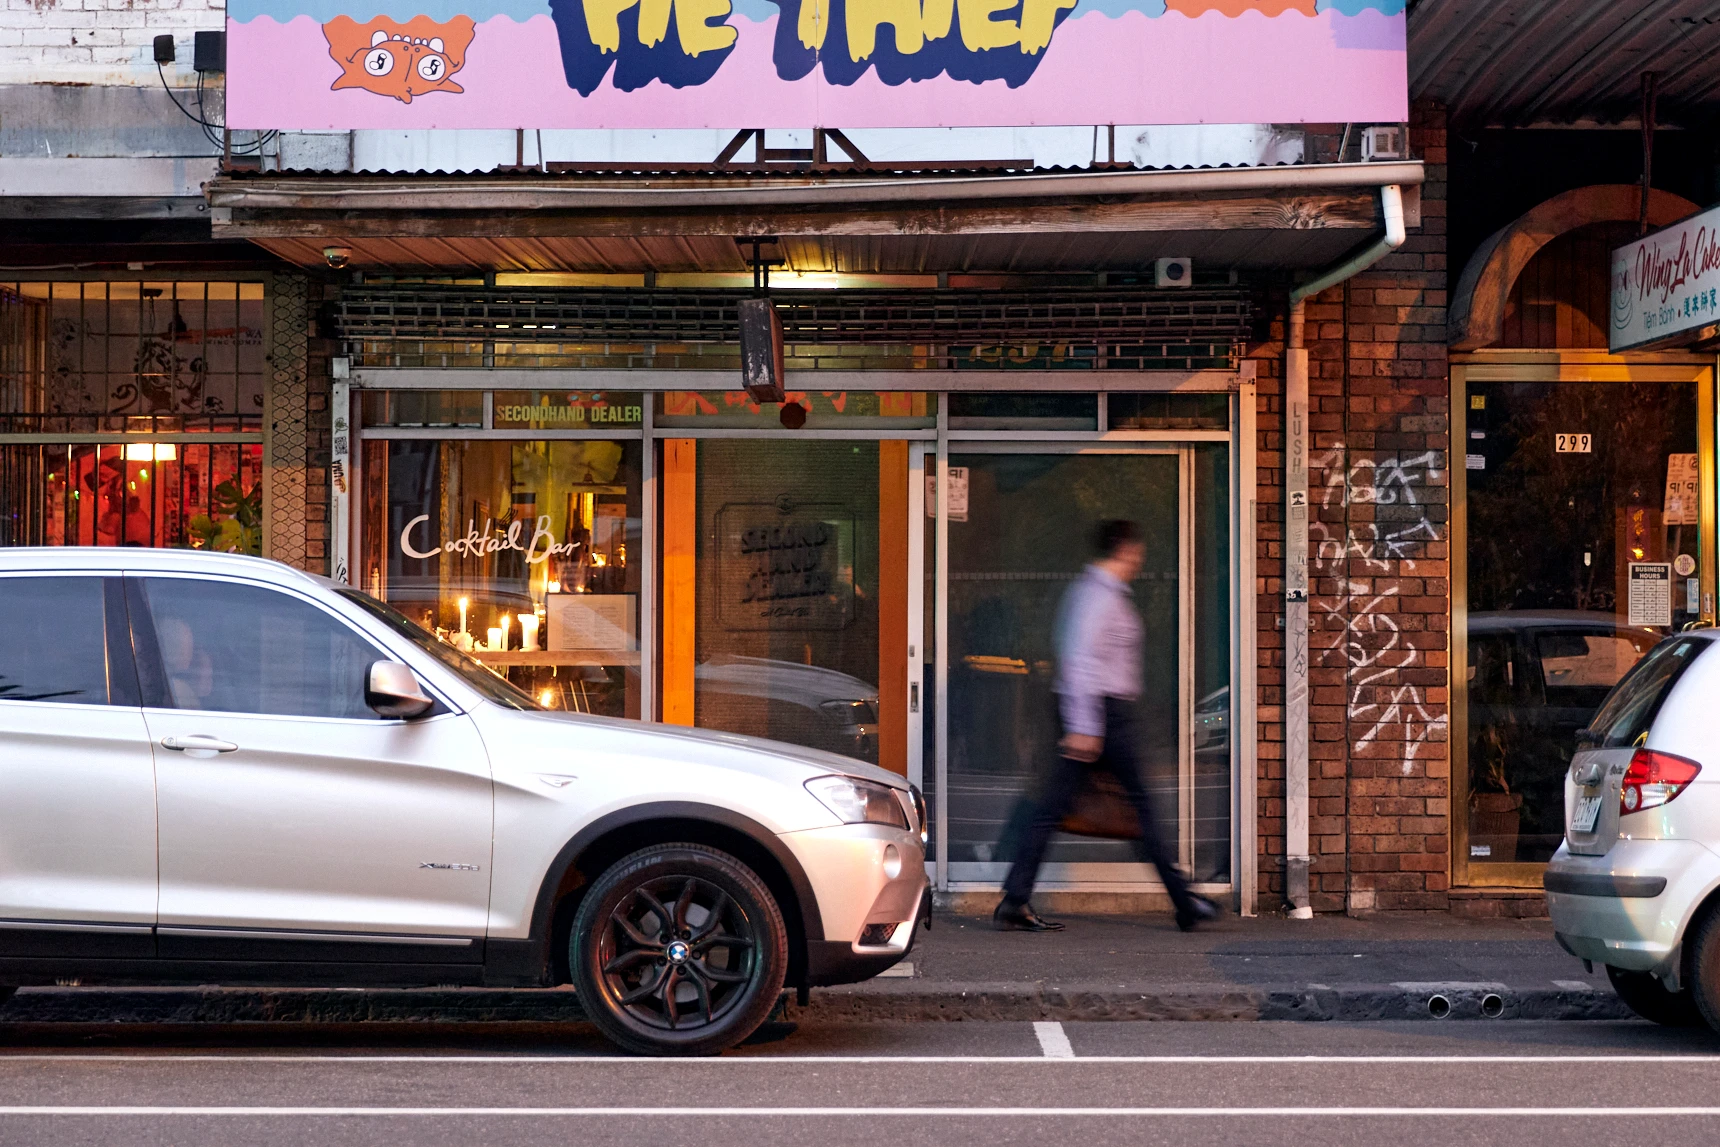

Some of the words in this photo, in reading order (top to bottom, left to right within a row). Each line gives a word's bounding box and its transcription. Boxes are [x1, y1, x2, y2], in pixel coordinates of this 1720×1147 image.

[1635, 241, 1673, 304] Wing
[1670, 231, 1692, 294] La
[495, 405, 585, 422] SECONDHAND
[591, 405, 642, 422] DEALER
[1292, 402, 1302, 473] LUSH
[1558, 435, 1589, 451] 299
[400, 514, 524, 559] Cocktail
[524, 514, 581, 564] Bar
